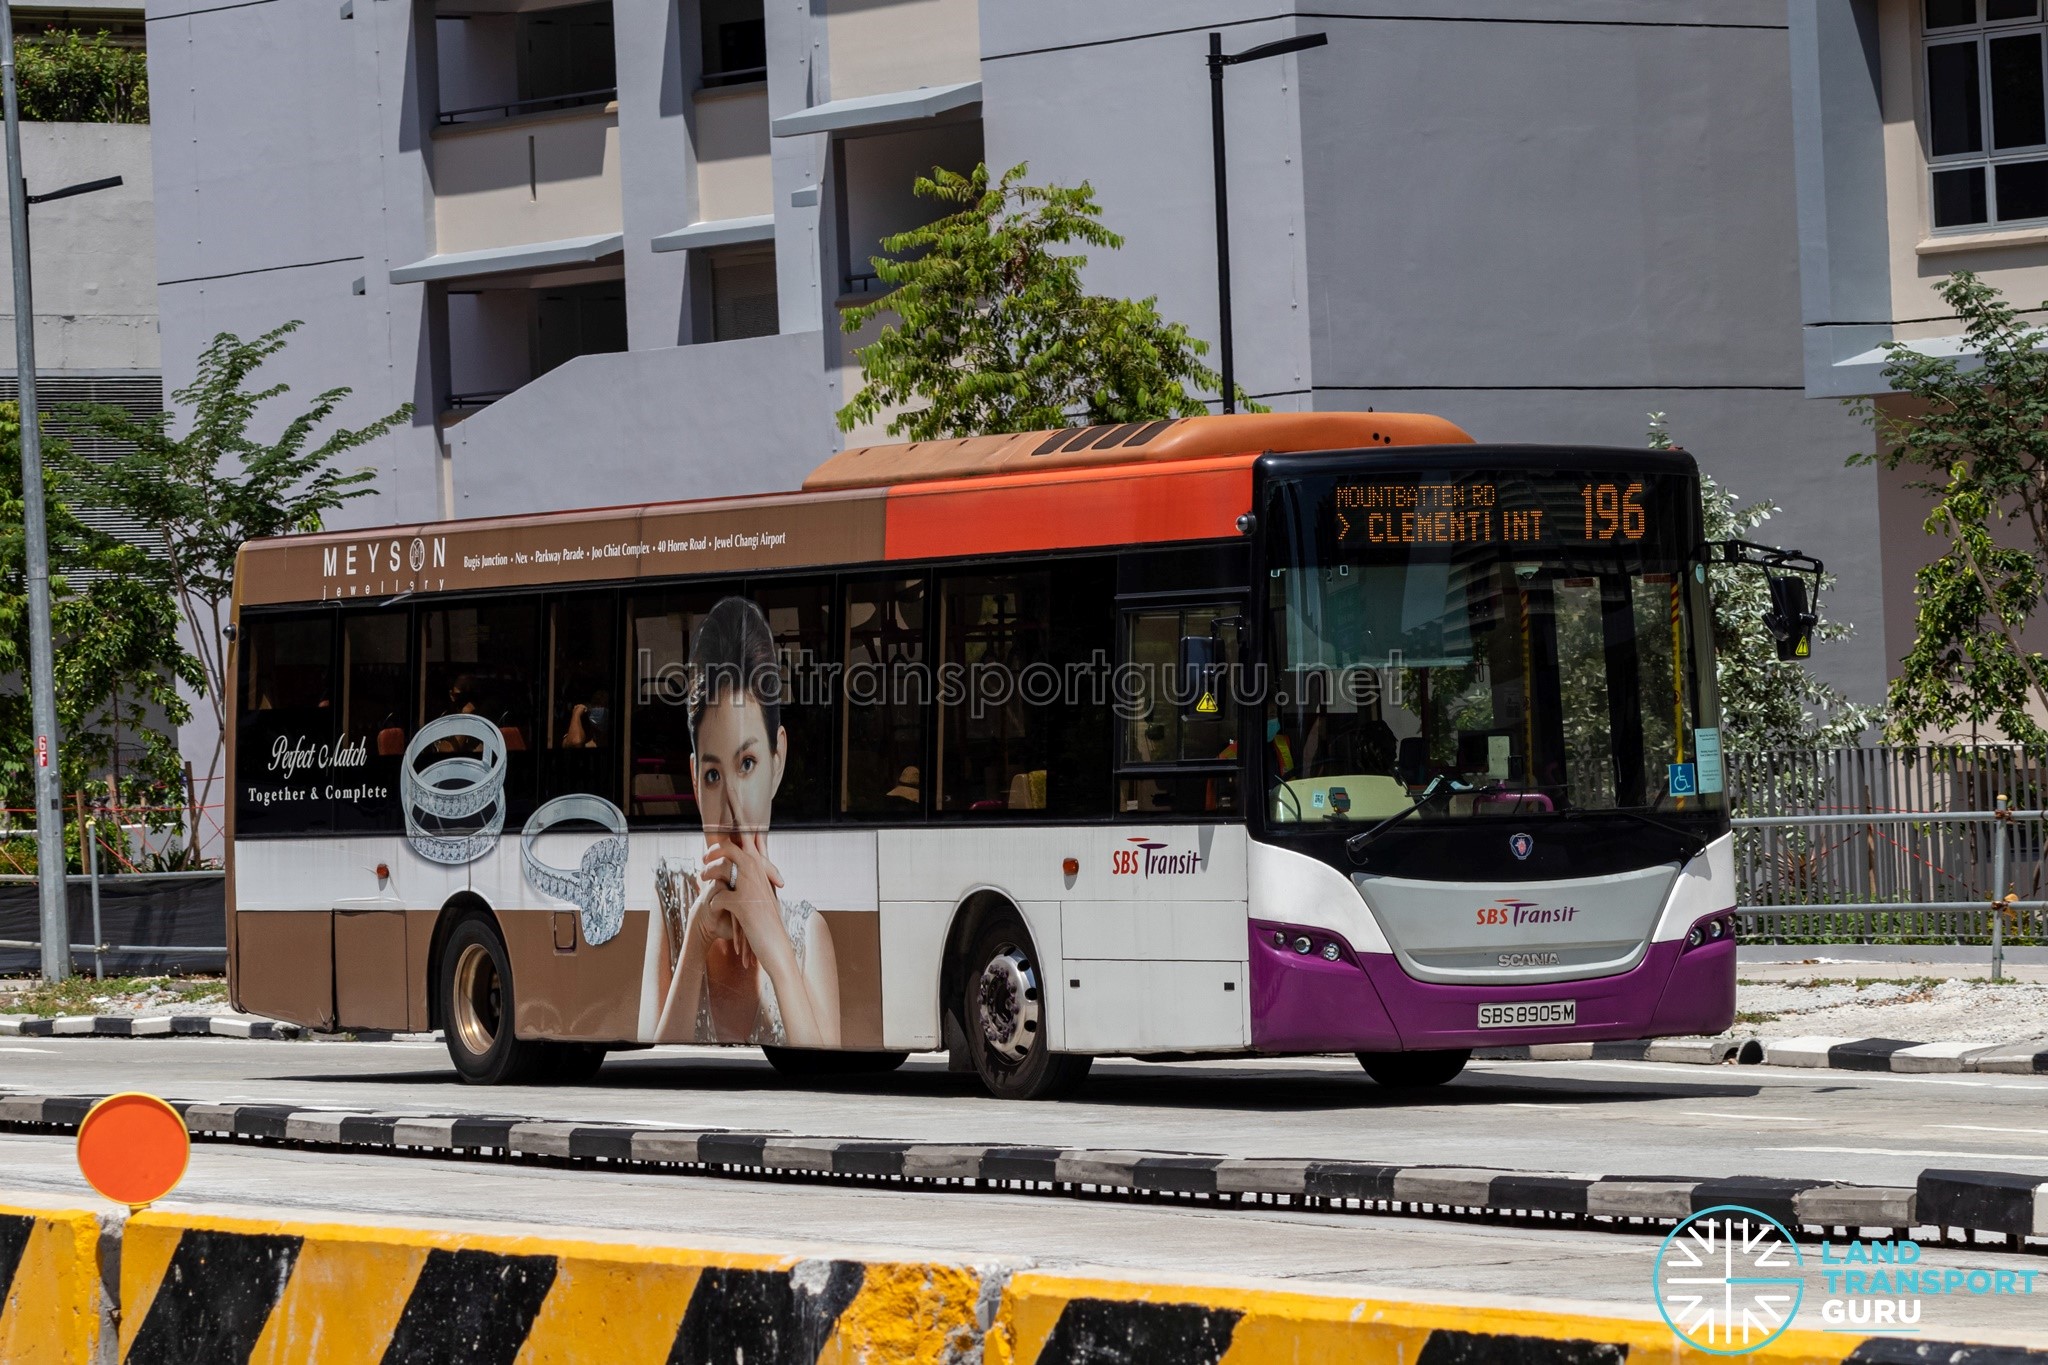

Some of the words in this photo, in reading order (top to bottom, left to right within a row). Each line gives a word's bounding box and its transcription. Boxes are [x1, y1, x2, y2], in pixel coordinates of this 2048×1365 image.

[1336, 485, 1464, 507] MOUNTBATTEN
[1472, 485, 1495, 506] RD
[1581, 484, 1645, 539] 196
[1368, 512, 1490, 543] CLEMENTI
[1503, 511, 1543, 541] INT
[323, 537, 446, 577] MEYSON
[463, 555, 480, 571] Bugis
[481, 553, 508, 568] Junction
[515, 552, 528, 564] Nex
[535, 549, 561, 565] Parkway
[563, 546, 584, 560] Parade
[591, 546, 602, 560] Joo
[603, 543, 621, 558] Chiat
[622, 541, 650, 559] Complex
[657, 540, 666, 552] 40
[689, 536, 706, 550] Road
[714, 534, 733, 551] Jewel
[734, 533, 759, 550] Changi
[760, 531, 786, 549] Airport
[322, 579, 444, 600] jewellery
[267, 735, 316, 779] Perfect
[318, 733, 367, 768] Match
[248, 786, 305, 806] Together
[310, 787, 319, 800] &
[325, 784, 388, 803] Complete
[1112, 850, 1139, 875] SBS
[1137, 843, 1203, 880] Transit
[1476, 908, 1508, 925] SBS
[1505, 903, 1581, 927] Transit
[1498, 952, 1560, 968] SCANIA
[1480, 1004, 1574, 1024] SBS8905M
